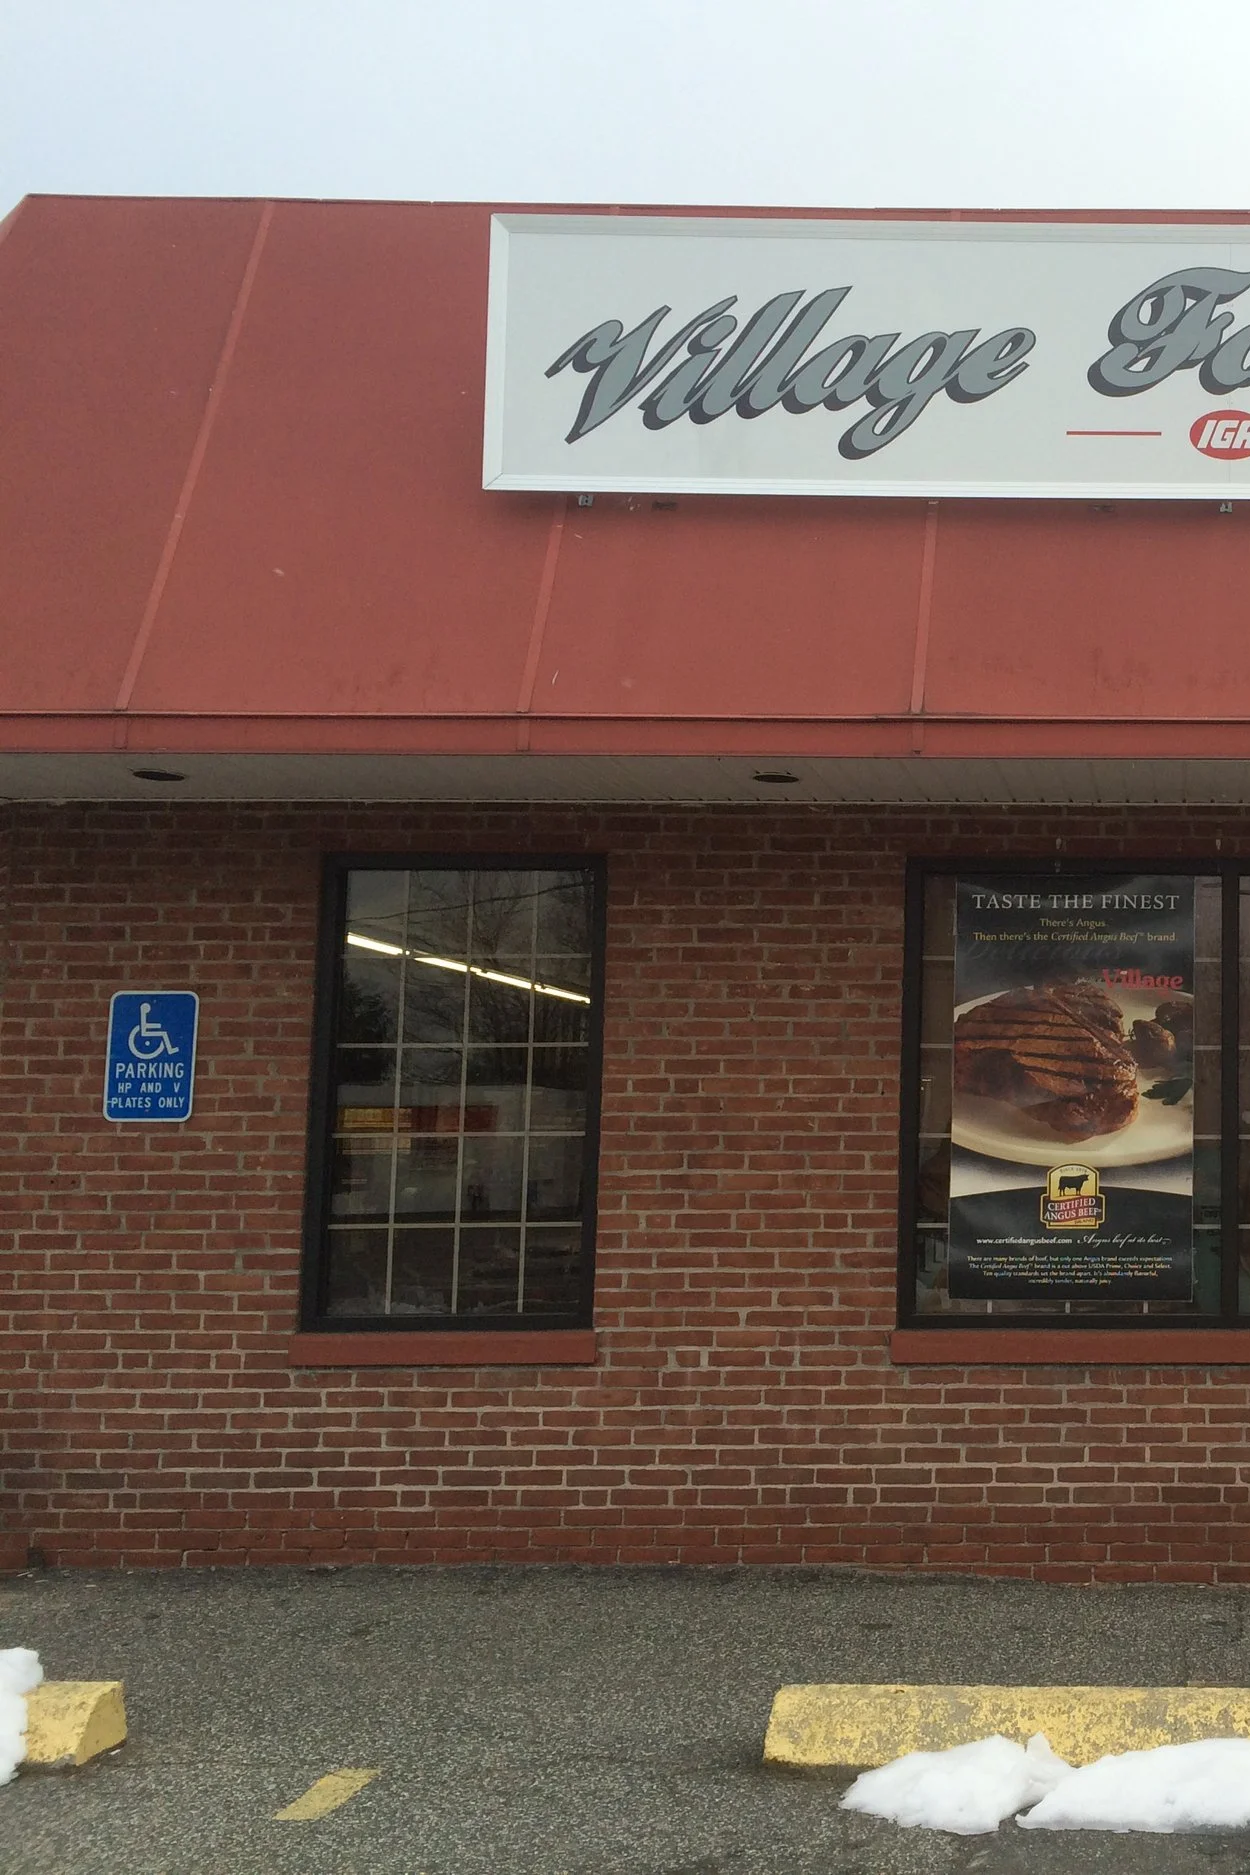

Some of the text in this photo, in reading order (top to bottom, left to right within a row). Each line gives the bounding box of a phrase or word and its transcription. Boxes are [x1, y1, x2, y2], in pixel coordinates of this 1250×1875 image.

[544, 285, 1036, 460] Village
[972, 894, 1180, 910] TASTE THE FINEST
[1040, 918, 1074, 929] There's
[973, 932, 997, 943] Then
[1000, 932, 1031, 943] there's
[1033, 932, 1049, 943] the
[1051, 932, 1088, 943] Certified
[1102, 968, 1183, 997] Village
[115, 1063, 185, 1079] PARKING
[118, 1083, 181, 1093] HP AND V
[111, 1097, 185, 1108] PLATES ONLY
[1047, 1198, 1096, 1211] CERTIFIED
[1044, 1210, 1077, 1220] ANGUS
